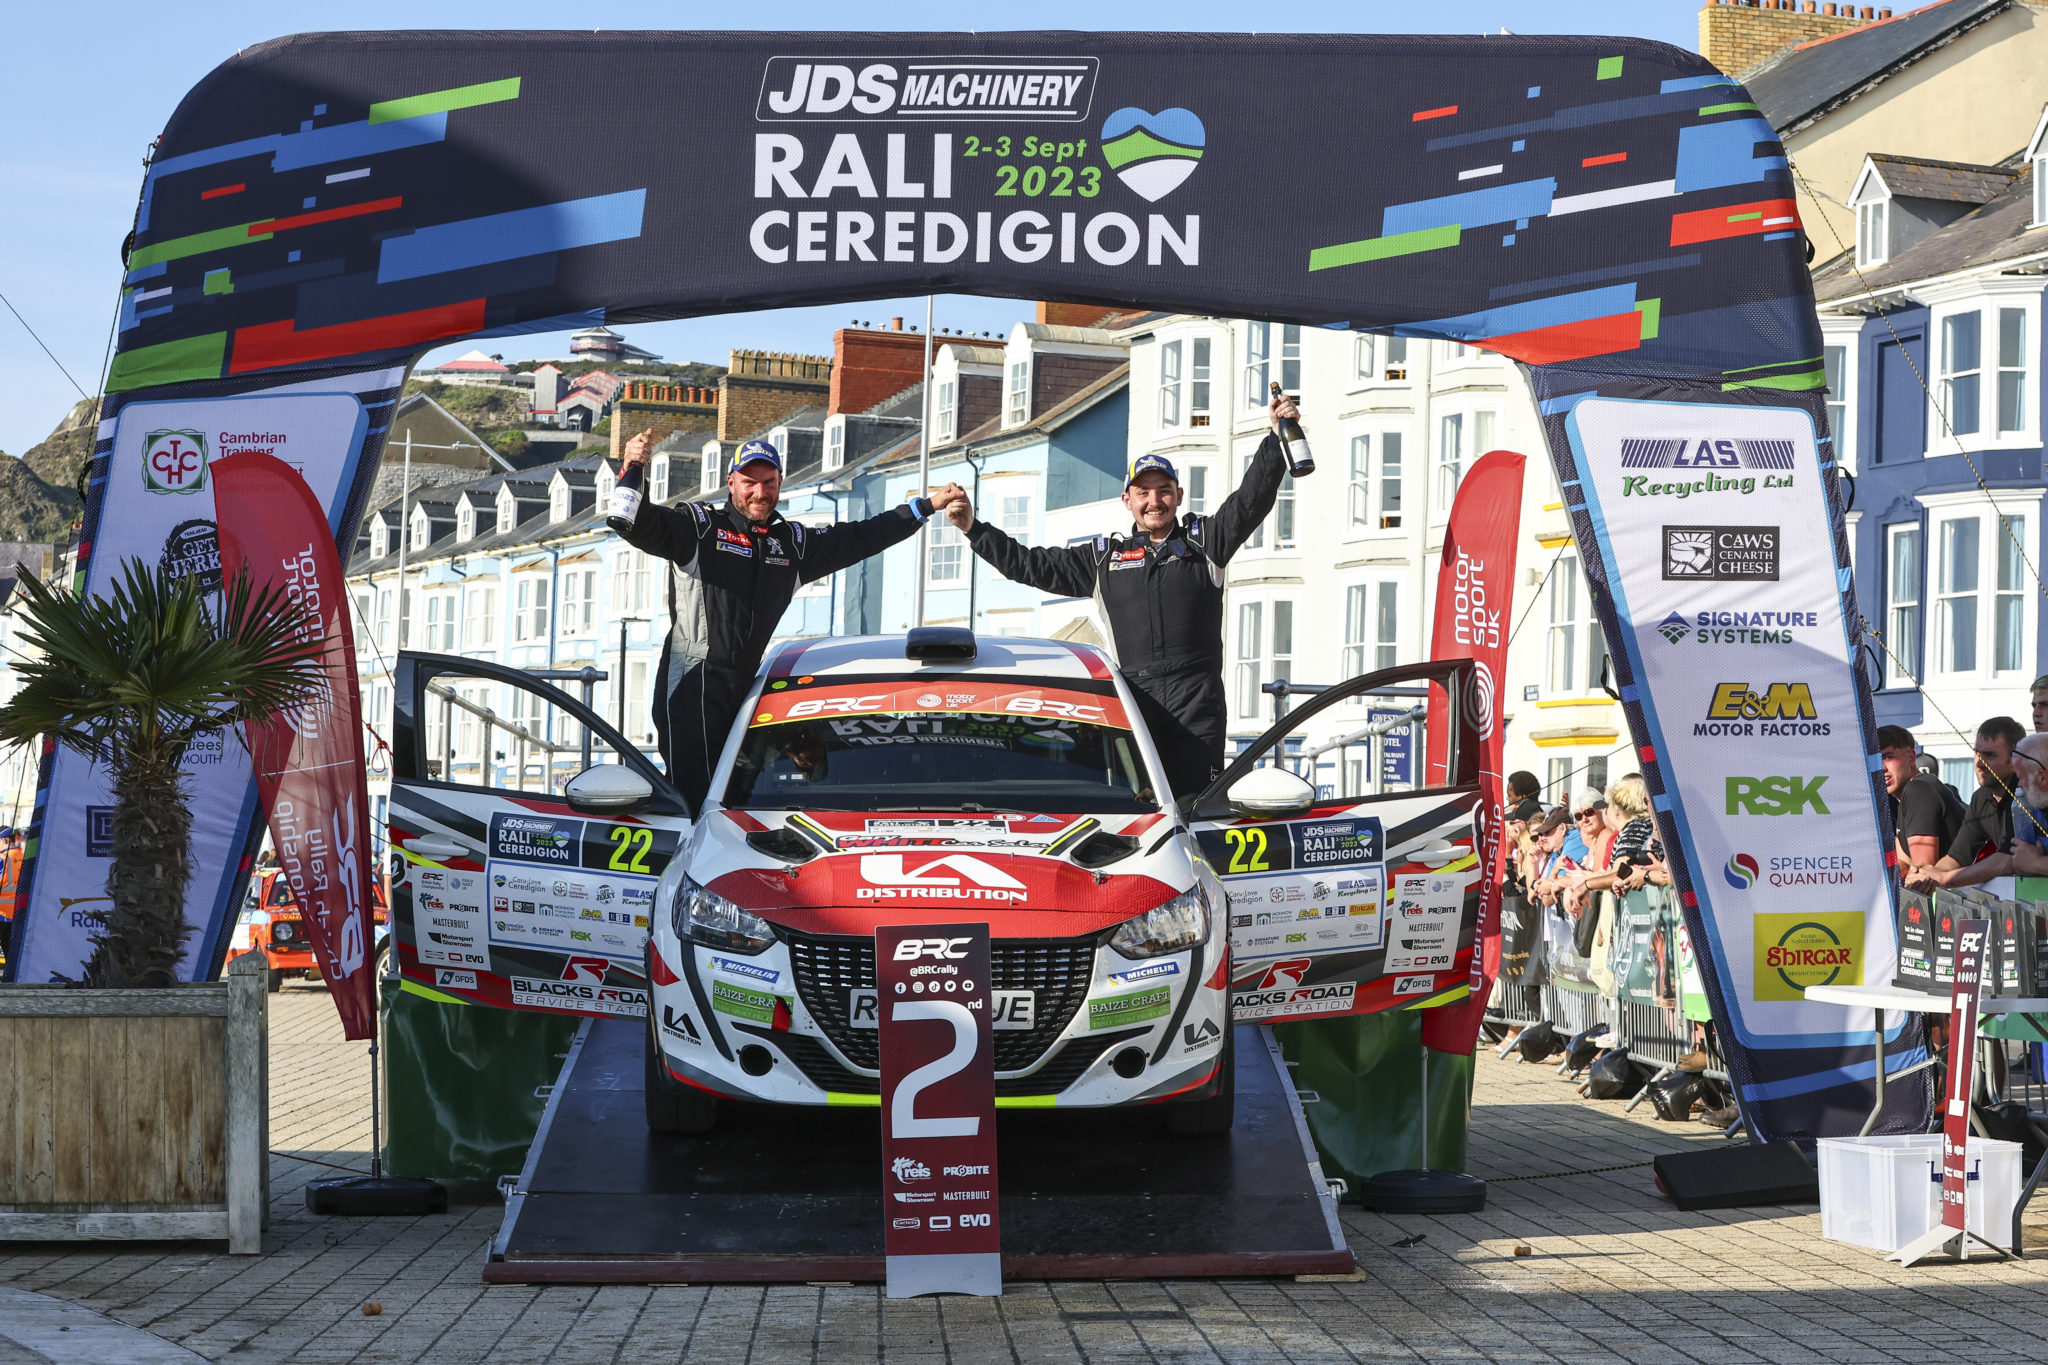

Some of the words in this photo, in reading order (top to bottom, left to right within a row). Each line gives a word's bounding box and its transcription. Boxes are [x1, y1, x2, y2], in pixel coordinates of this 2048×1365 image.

[769, 64, 898, 114] JDS
[901, 73, 1084, 107] MACHINERY
[963, 136, 1011, 157] 2-3
[1023, 136, 1087, 162] Sept
[755, 133, 952, 198] RALI
[994, 165, 1101, 197] 2023
[749, 210, 1199, 266] CEREDIGION
[219, 432, 286, 443] Cambrian
[1672, 440, 1741, 467] LAS
[1622, 471, 1756, 498] Recycling
[1763, 474, 1794, 488] Ltd
[182, 537, 217, 557] GET
[1719, 534, 1774, 549] CAWS
[1719, 551, 1774, 560] CENARTH
[169, 553, 222, 579] JERK
[1718, 561, 1773, 574] CHEESE
[1454, 545, 1470, 645] motor
[1470, 558, 1485, 647] sport
[1697, 611, 1818, 627] SIGNATURE
[1488, 609, 1501, 649] uk
[1697, 629, 1793, 644] SYSTEMS
[786, 695, 889, 718] BRC
[1004, 697, 1107, 721] BRC
[1706, 683, 1818, 720] E&M
[1693, 722, 1754, 736] MOTOR
[1760, 722, 1831, 736] FACTORS
[1725, 776, 1831, 816] RSK
[502, 818, 524, 829] JDS
[499, 829, 530, 844] RALI
[1304, 826, 1324, 837] JDS
[499, 843, 569, 860] CEREDIGION
[609, 826, 653, 874] 22
[1225, 827, 1270, 873] 22
[1303, 837, 1335, 851] RALI
[1303, 848, 1373, 863] CEREDIGION
[1770, 856, 1852, 871] SPENCER
[1769, 872, 1853, 887] QUANTUM
[856, 887, 1028, 902] DISTRIBUTION
[427, 898, 444, 909] reis
[449, 903, 480, 913] PROBITE
[1406, 904, 1423, 915] reis
[1428, 906, 1456, 915] PROBITE
[432, 918, 469, 930] MASTERBUILT
[1408, 923, 1444, 932] MASTERBUILT
[441, 933, 474, 942] Motorsport
[570, 930, 592, 942] RSK
[1286, 933, 1307, 943] RSK
[1414, 938, 1445, 946] Motorsport
[1960, 932, 1983, 953] BRC
[441, 940, 473, 948] Showroom
[893, 937, 974, 961] BRC
[465, 954, 484, 964] evo
[1431, 956, 1449, 964] evo
[725, 962, 776, 979] MICHELIN
[910, 965, 958, 977] @BRCrally
[1127, 964, 1175, 980] MICHELIN
[1412, 980, 1432, 988] DFDS
[513, 980, 593, 999] BLACKS
[598, 989, 647, 1005] ROA
[714, 985, 746, 1002] BAIZE
[1233, 991, 1286, 1008] ACKS
[1289, 985, 1354, 1002] ROAD
[514, 994, 584, 1009] SERVICE
[1091, 1000, 1129, 1014] BAIZE
[1131, 990, 1170, 1007] CRAFT
[1284, 1000, 1353, 1014] STATION
[892, 1000, 980, 1139] 2
[968, 998, 982, 1009] nd
[904, 1162, 931, 1178] reis
[943, 1164, 990, 1177] PROBITE
[943, 1191, 990, 1201] MASTERBUILT
[960, 1213, 991, 1228] evo
